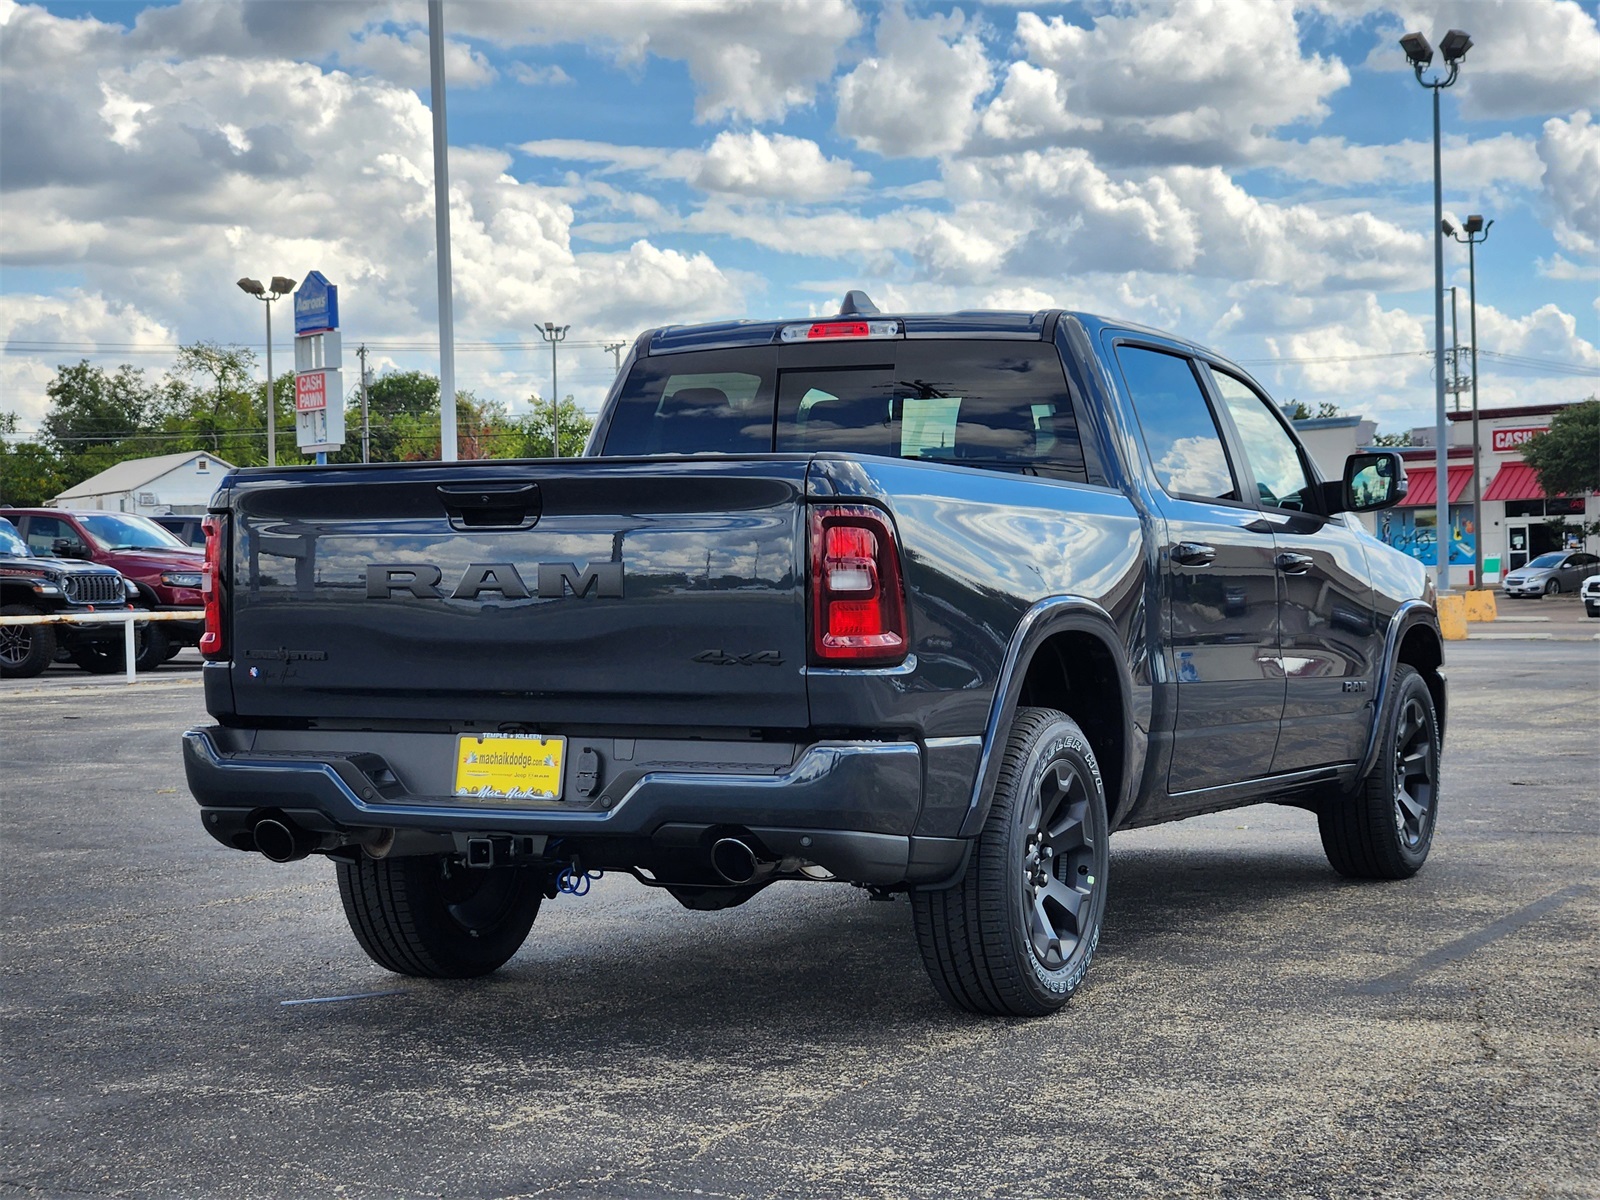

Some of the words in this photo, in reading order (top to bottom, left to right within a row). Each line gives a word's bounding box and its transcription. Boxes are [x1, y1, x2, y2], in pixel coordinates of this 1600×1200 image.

[300, 374, 322, 392] CASH
[300, 391, 324, 409] PAWN
[1495, 430, 1534, 449] CASH
[366, 562, 625, 600] RAM
[479, 752, 542, 768] machaikdodge.com
